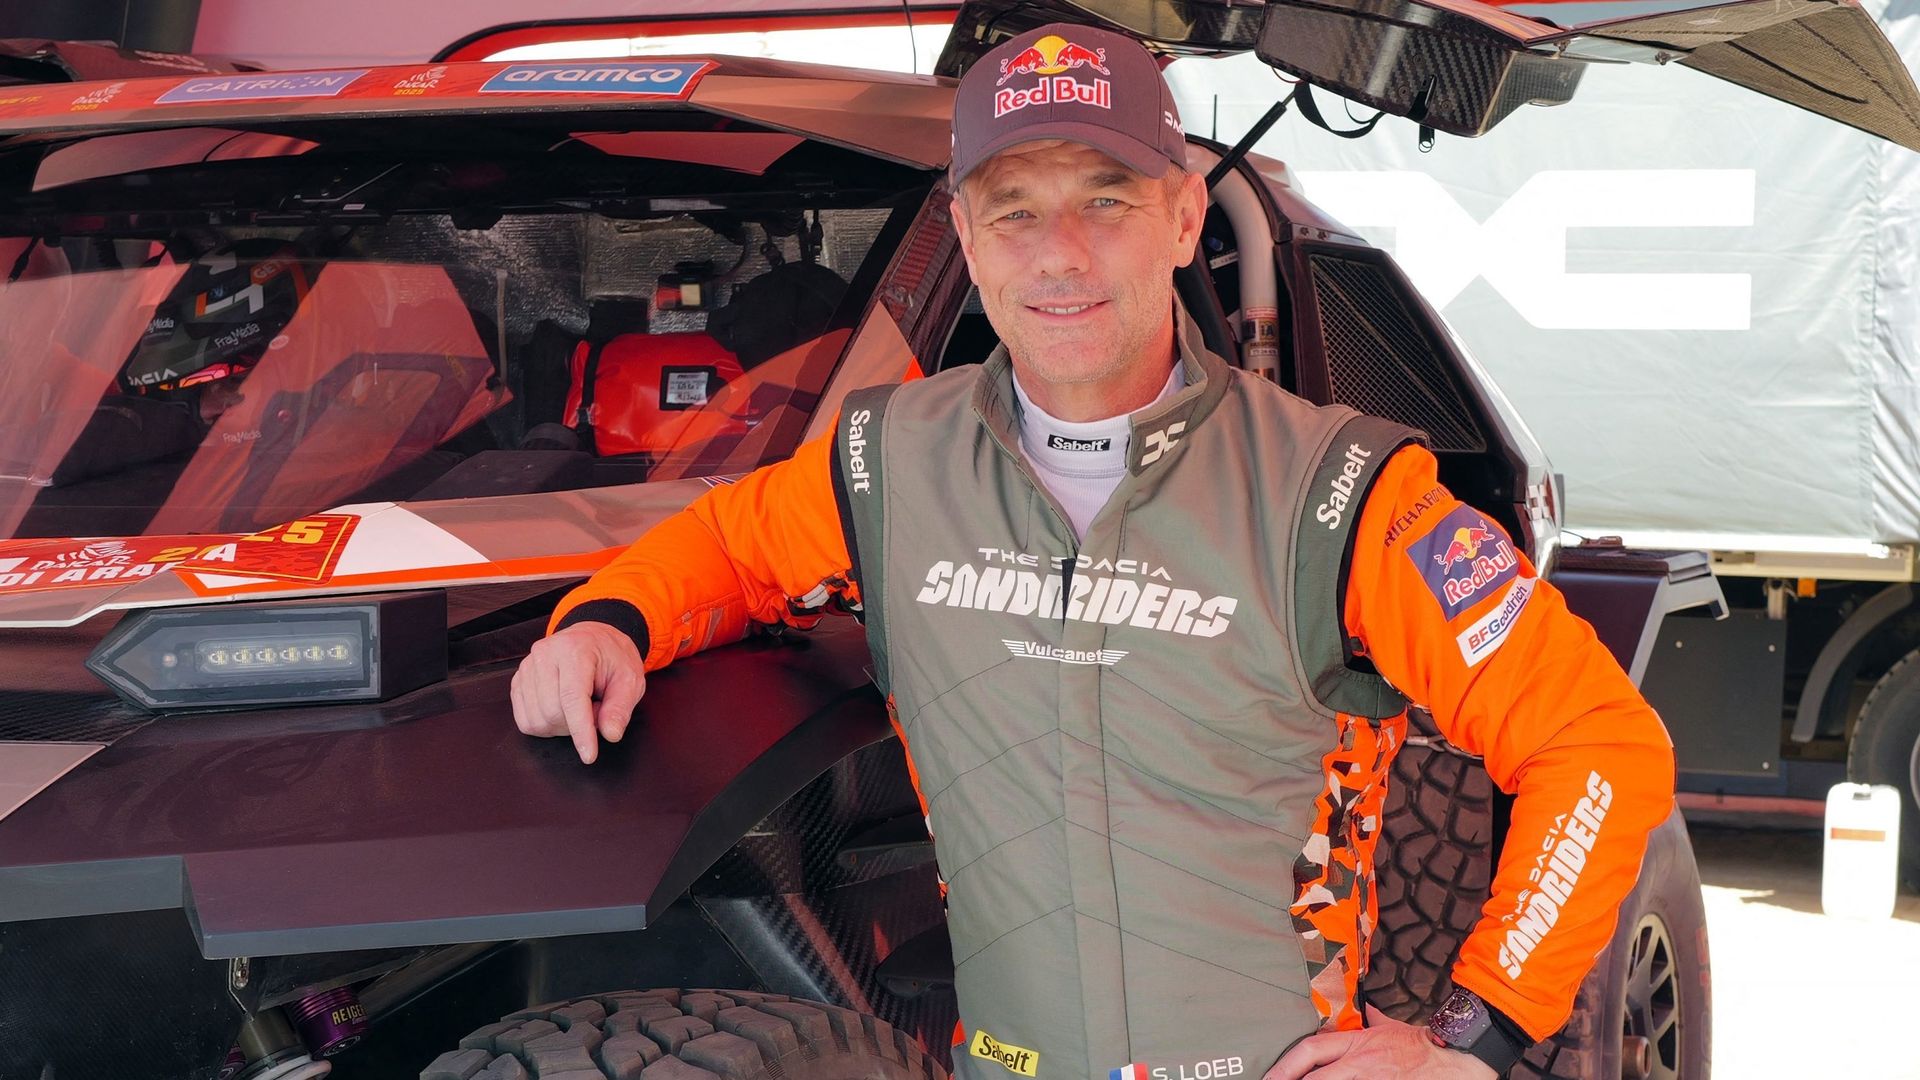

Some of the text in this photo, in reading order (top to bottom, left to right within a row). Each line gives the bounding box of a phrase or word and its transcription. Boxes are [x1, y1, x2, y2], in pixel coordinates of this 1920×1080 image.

[393, 88, 425, 96] 2025
[504, 67, 683, 83] aramco
[995, 76, 1111, 119] Red Bull
[849, 409, 871, 495] Sabelt
[1052, 436, 1106, 452] Sabelt
[1315, 442, 1372, 530] Sabelt
[30, 555, 136, 572] DAKAR
[978, 547, 1039, 568] THE
[1443, 539, 1517, 607] Red Bull
[915, 560, 1239, 639] SANDRIDERS
[1468, 584, 1528, 651] BFGoodrich
[1024, 640, 1104, 663] Vulcanet
[1528, 812, 1568, 883] DACIA
[1498, 769, 1614, 981] SANDRIDERS
[978, 1034, 1032, 1073] Sabelt
[1179, 1056, 1245, 1080] LOEB
